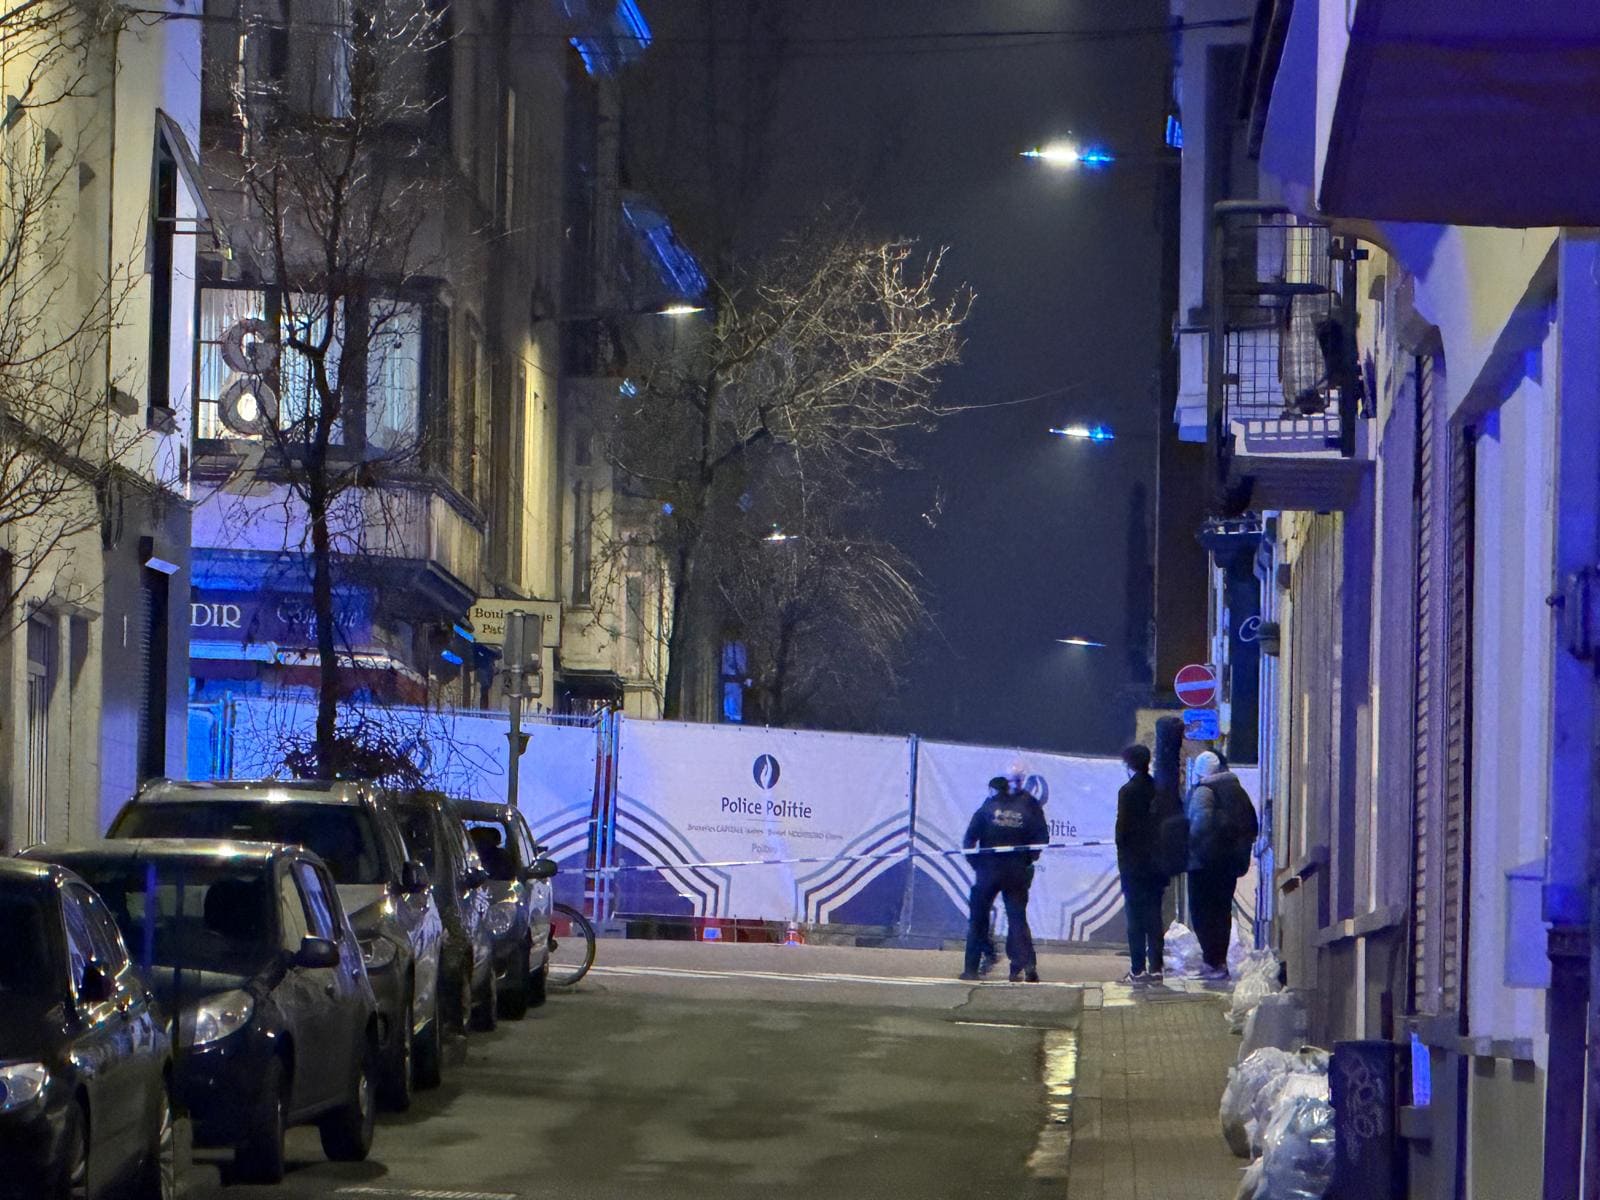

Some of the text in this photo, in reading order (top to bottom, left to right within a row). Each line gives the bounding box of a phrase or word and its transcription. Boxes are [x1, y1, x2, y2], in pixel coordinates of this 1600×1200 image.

[721, 797, 812, 818] Police Politie
[1047, 819, 1077, 837] litie
